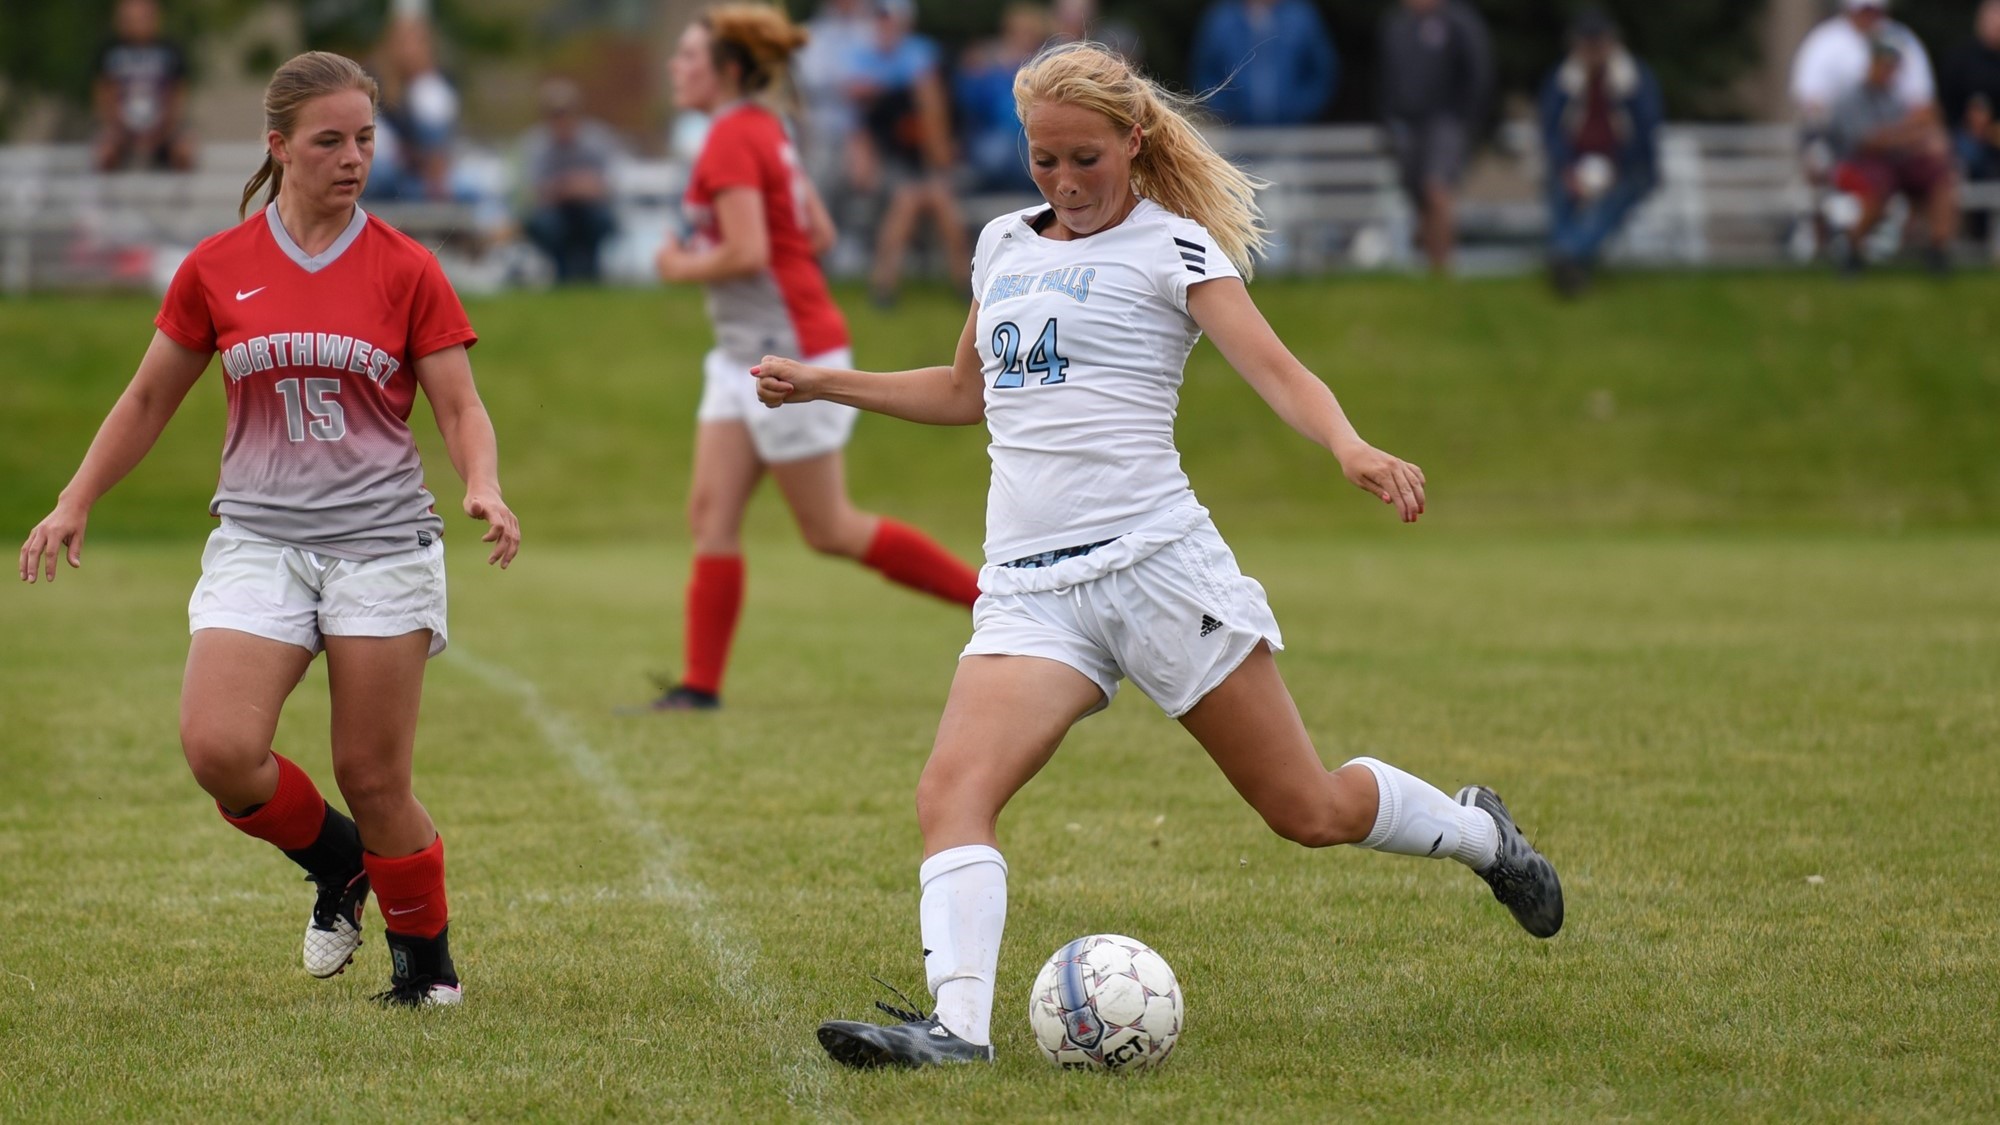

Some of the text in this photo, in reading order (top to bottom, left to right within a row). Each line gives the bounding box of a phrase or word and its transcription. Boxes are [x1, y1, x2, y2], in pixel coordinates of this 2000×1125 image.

[982, 267, 1096, 312] GREAT FALLS
[222, 332, 400, 390] NORTHWEST
[992, 317, 1069, 389] 24
[275, 378, 346, 442] 15
[1200, 620, 1224, 638] adidas
